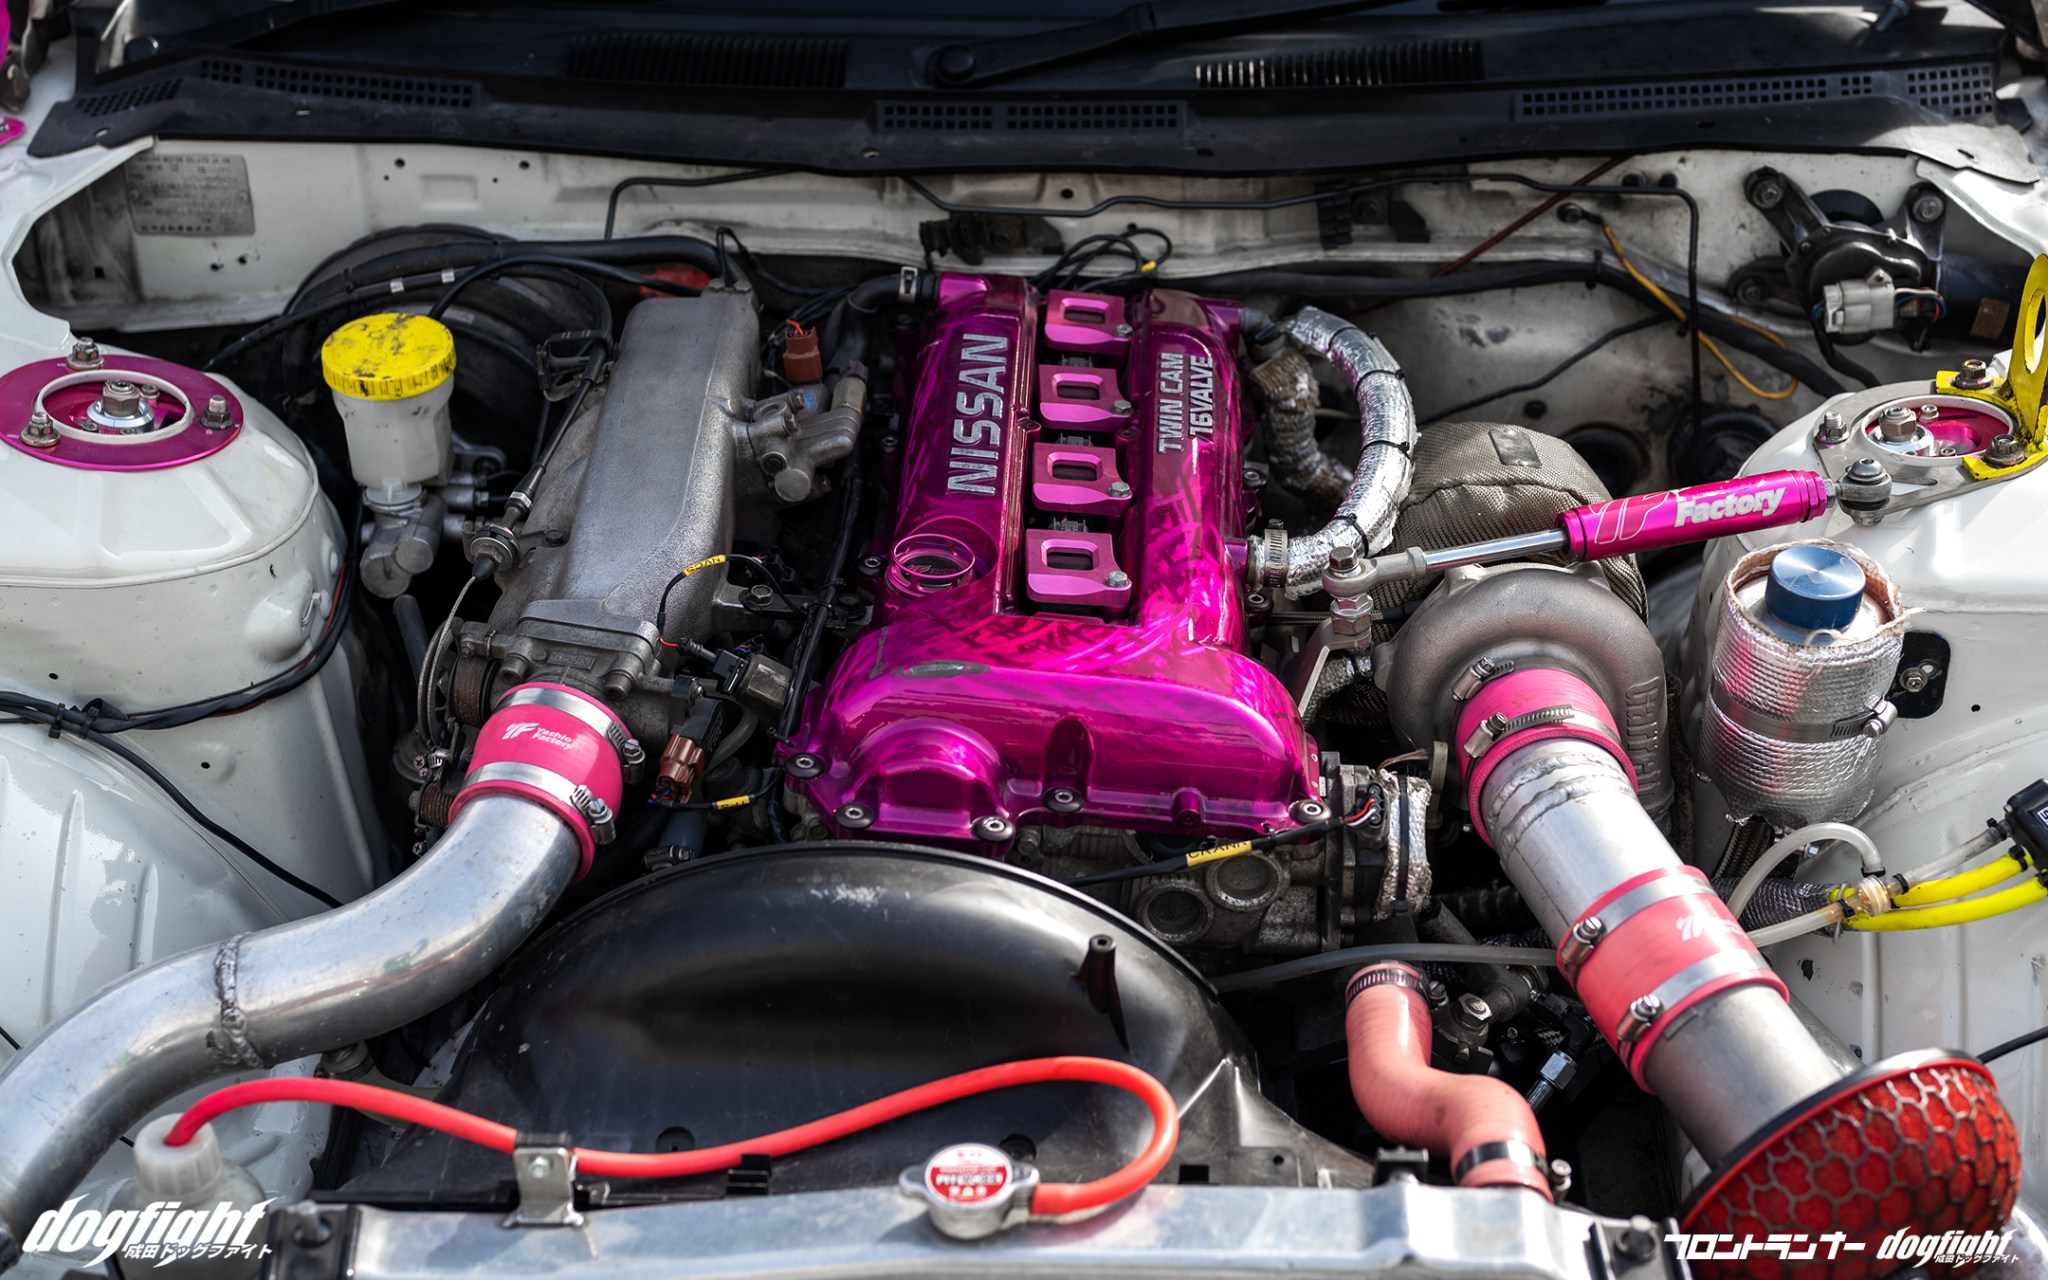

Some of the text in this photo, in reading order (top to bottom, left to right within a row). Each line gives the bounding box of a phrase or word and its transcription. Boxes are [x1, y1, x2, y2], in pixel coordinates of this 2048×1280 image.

[947, 333, 1008, 495] NISSAN
[1158, 352, 1184, 453] TWIN CAM
[1189, 354, 1214, 437] 16VALVE
[1674, 487, 1786, 528] Factory
[531, 733, 573, 751] Factory
